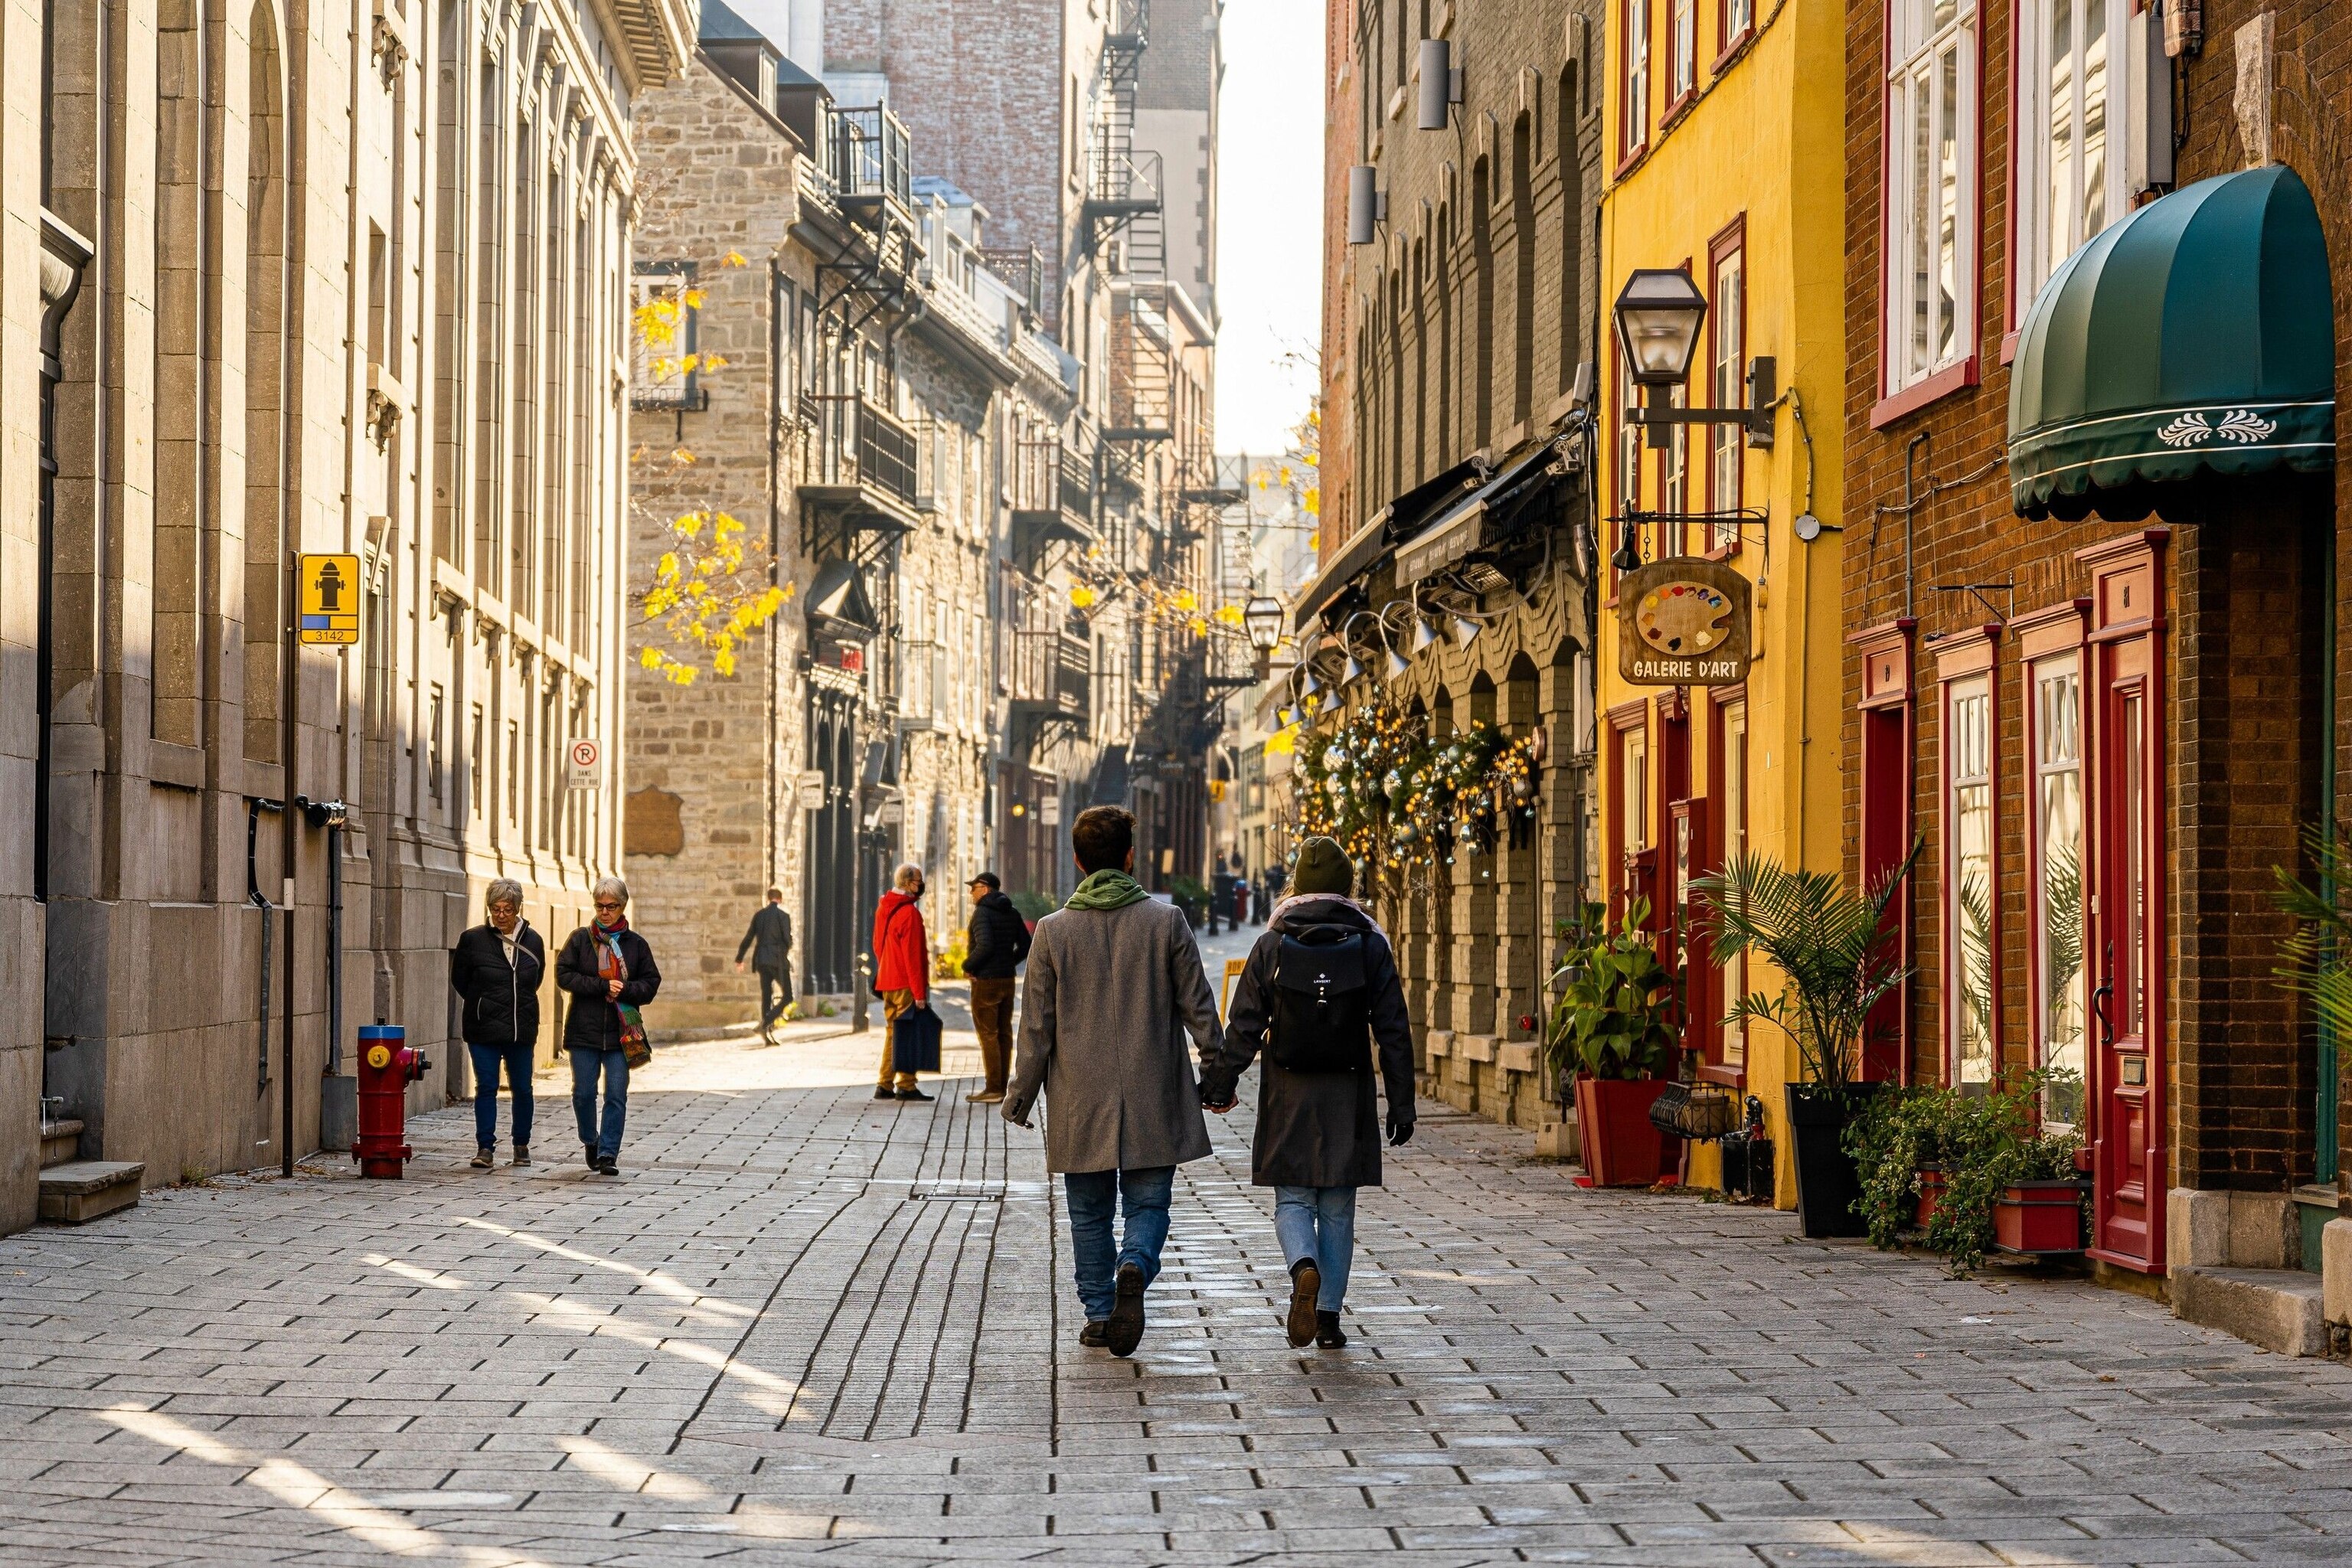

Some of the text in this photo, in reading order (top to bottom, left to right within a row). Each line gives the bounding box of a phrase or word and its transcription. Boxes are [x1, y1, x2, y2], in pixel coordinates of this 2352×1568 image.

[315, 631, 344, 641] 3142
[1633, 660, 1738, 678] GALERIE D'ART
[581, 748, 590, 760] P
